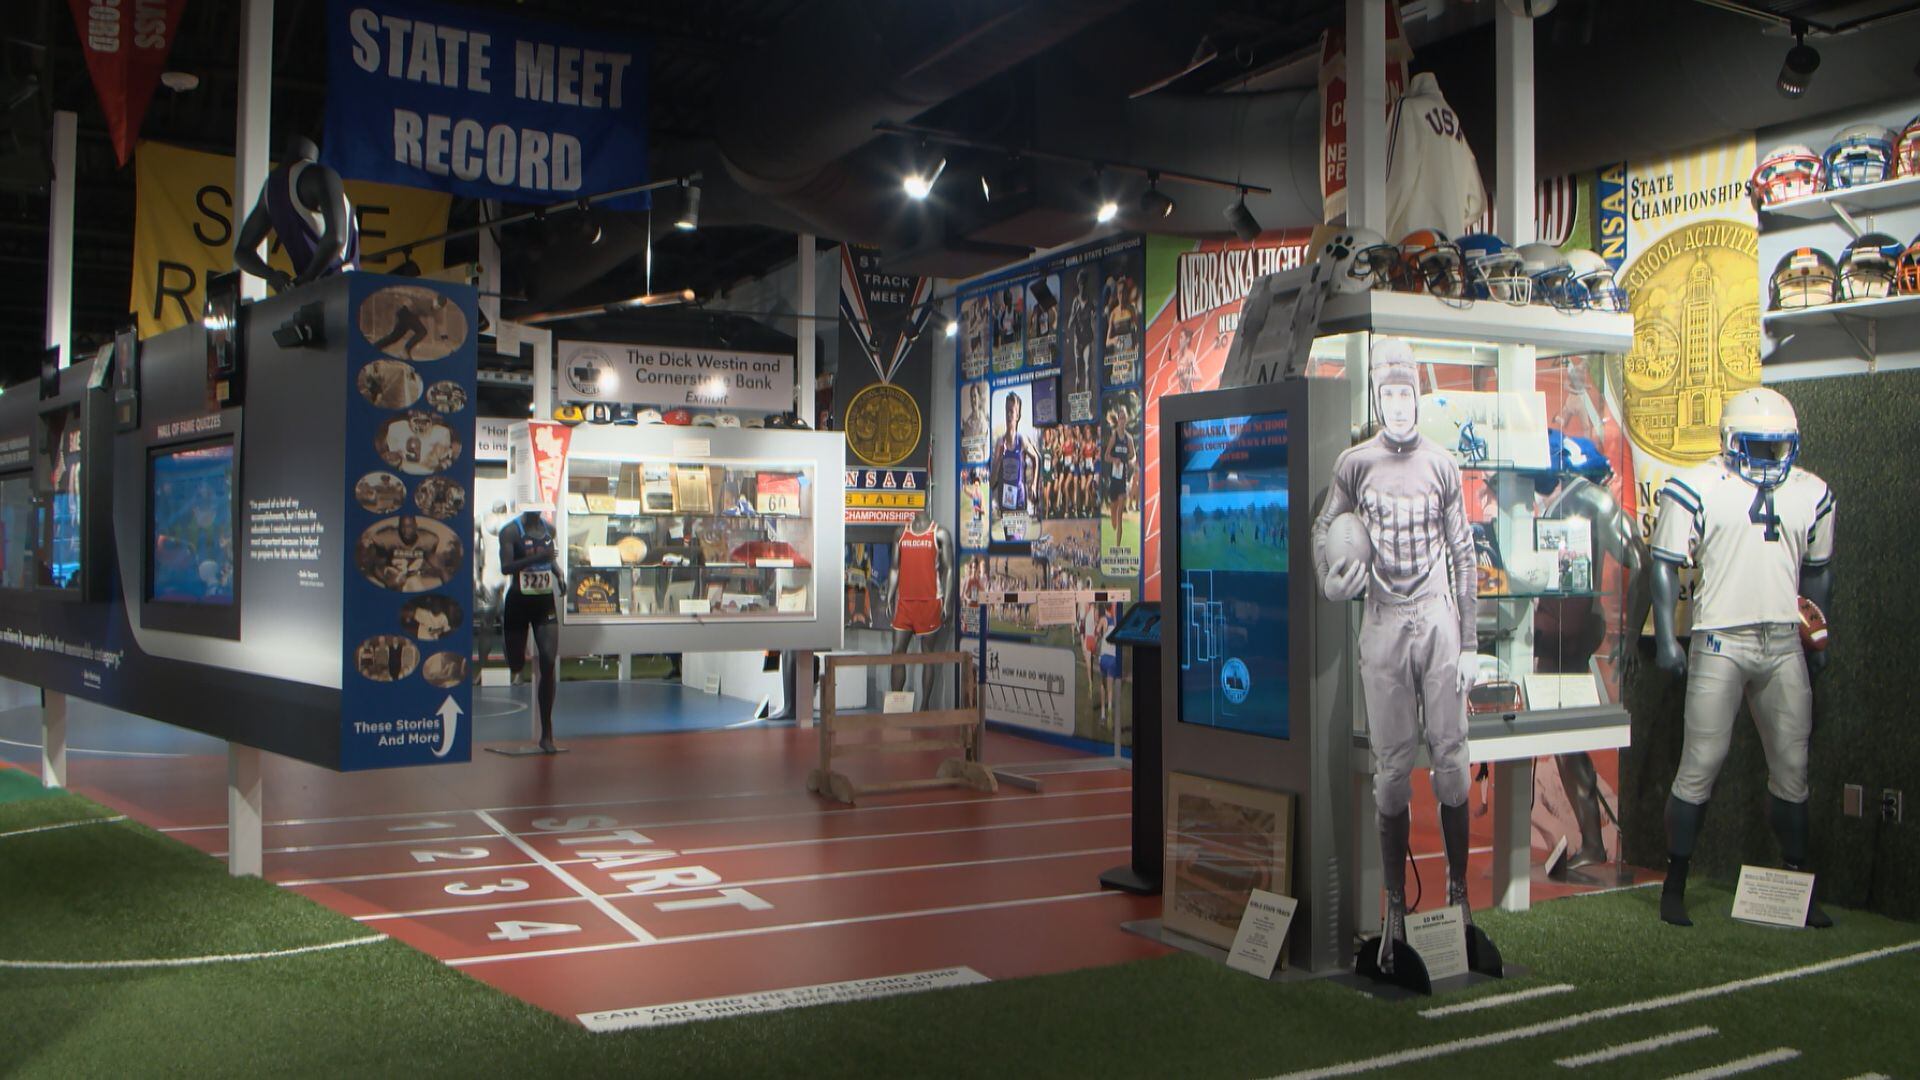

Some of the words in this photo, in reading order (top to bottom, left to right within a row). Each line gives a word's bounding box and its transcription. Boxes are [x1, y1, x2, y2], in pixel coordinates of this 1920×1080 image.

[350, 8, 491, 94] STATE
[515, 40, 632, 109] MEET
[394, 108, 582, 192] RECORD
[1602, 161, 1625, 259] NSAA
[863, 273, 910, 288] TRACK
[1180, 249, 1254, 322] NEBRASKA
[870, 290, 906, 304] MEET
[626, 348, 654, 366] The
[659, 352, 692, 368] Dick
[697, 355, 748, 371] Westin
[752, 359, 781, 373] and
[735, 374, 772, 390] Bank
[171, 422, 180, 437] OF
[845, 470, 917, 489] NSAA
[845, 493, 915, 505] STATE
[845, 511, 916, 521] CHAMPIONSHIPS
[1749, 485, 1781, 542] 4
[901, 539, 932, 548] WILDCATS
[523, 571, 551, 589] 3229
[354, 720, 393, 734] These
[396, 717, 440, 731] Stories
[378, 733, 405, 746] And
[408, 731, 440, 744] More
[409, 846, 490, 863] 2
[532, 814, 774, 913] START
[444, 878, 530, 896] 3
[487, 919, 582, 942] 4
[594, 1010, 638, 1022] CAN
[646, 1005, 689, 1015] YOU
[694, 999, 744, 1009] FIND
[748, 993, 788, 1003] THE
[791, 984, 851, 996] STATE
[854, 977, 908, 989] LONG
[912, 970, 960, 981] JUMP
[651, 1011, 697, 1022] AND
[700, 1003, 776, 1016] TRIPLE
[777, 995, 831, 1007] JUMP
[834, 981, 935, 998] RECORDS?
